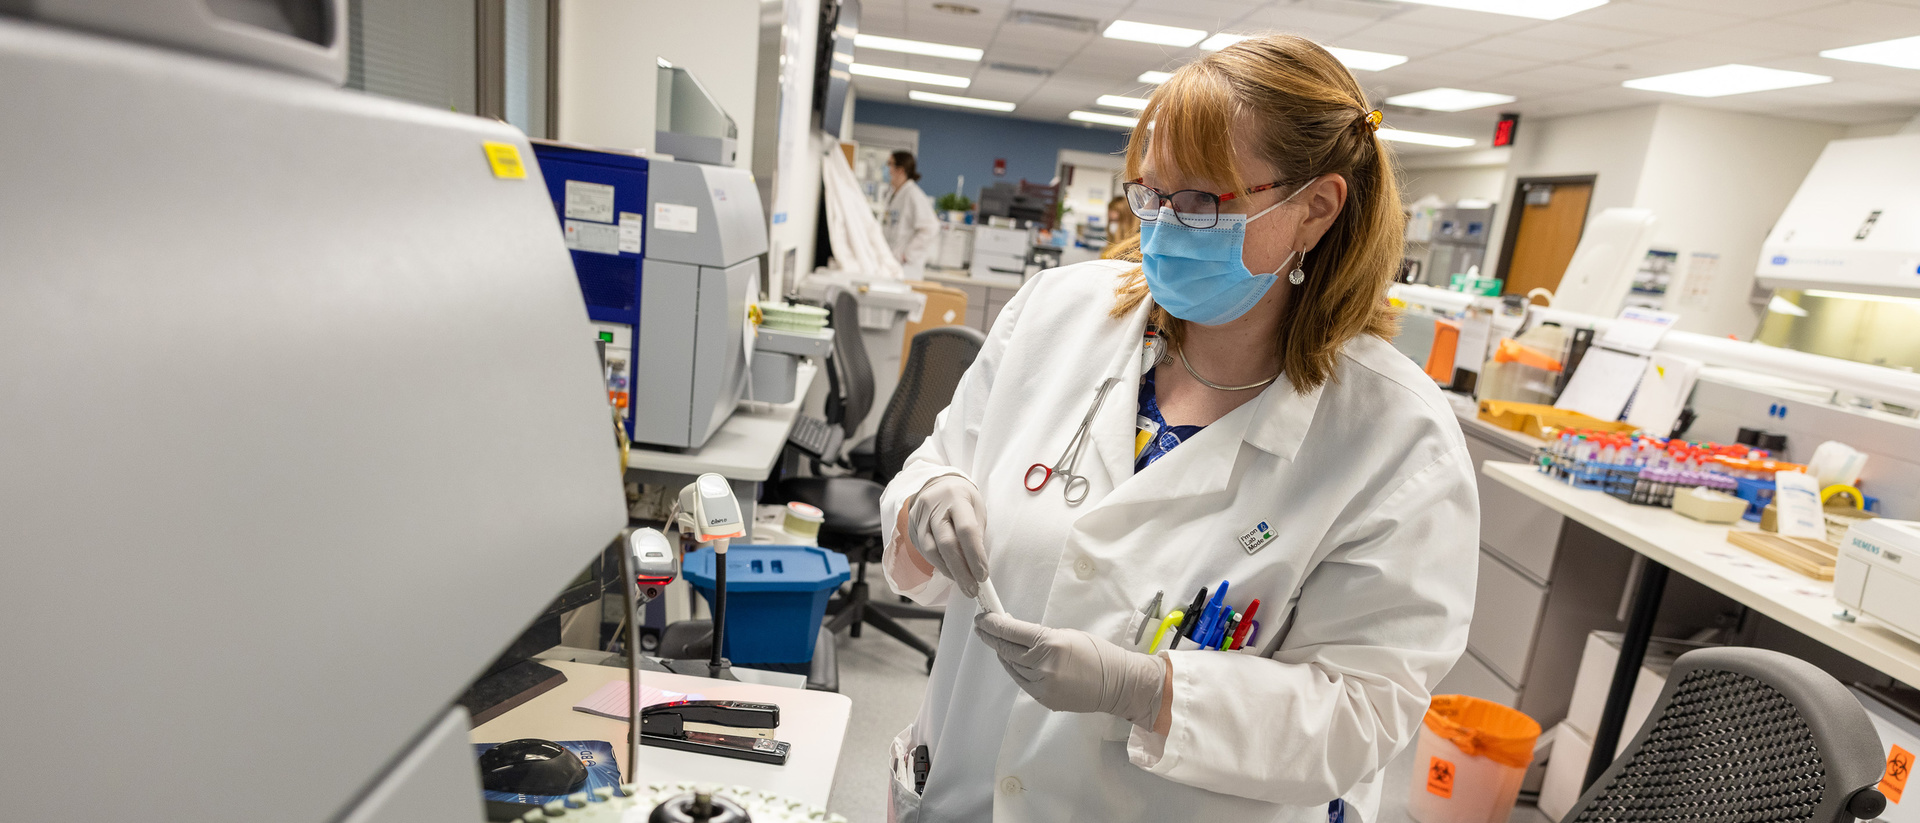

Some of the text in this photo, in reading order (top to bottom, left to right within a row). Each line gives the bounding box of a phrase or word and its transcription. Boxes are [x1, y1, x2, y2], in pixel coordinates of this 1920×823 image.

[1244, 537, 1256, 546] Lab
[1248, 538, 1264, 551] Mode
[1852, 537, 1880, 555] SIEMENS
[580, 750, 593, 760] BD
